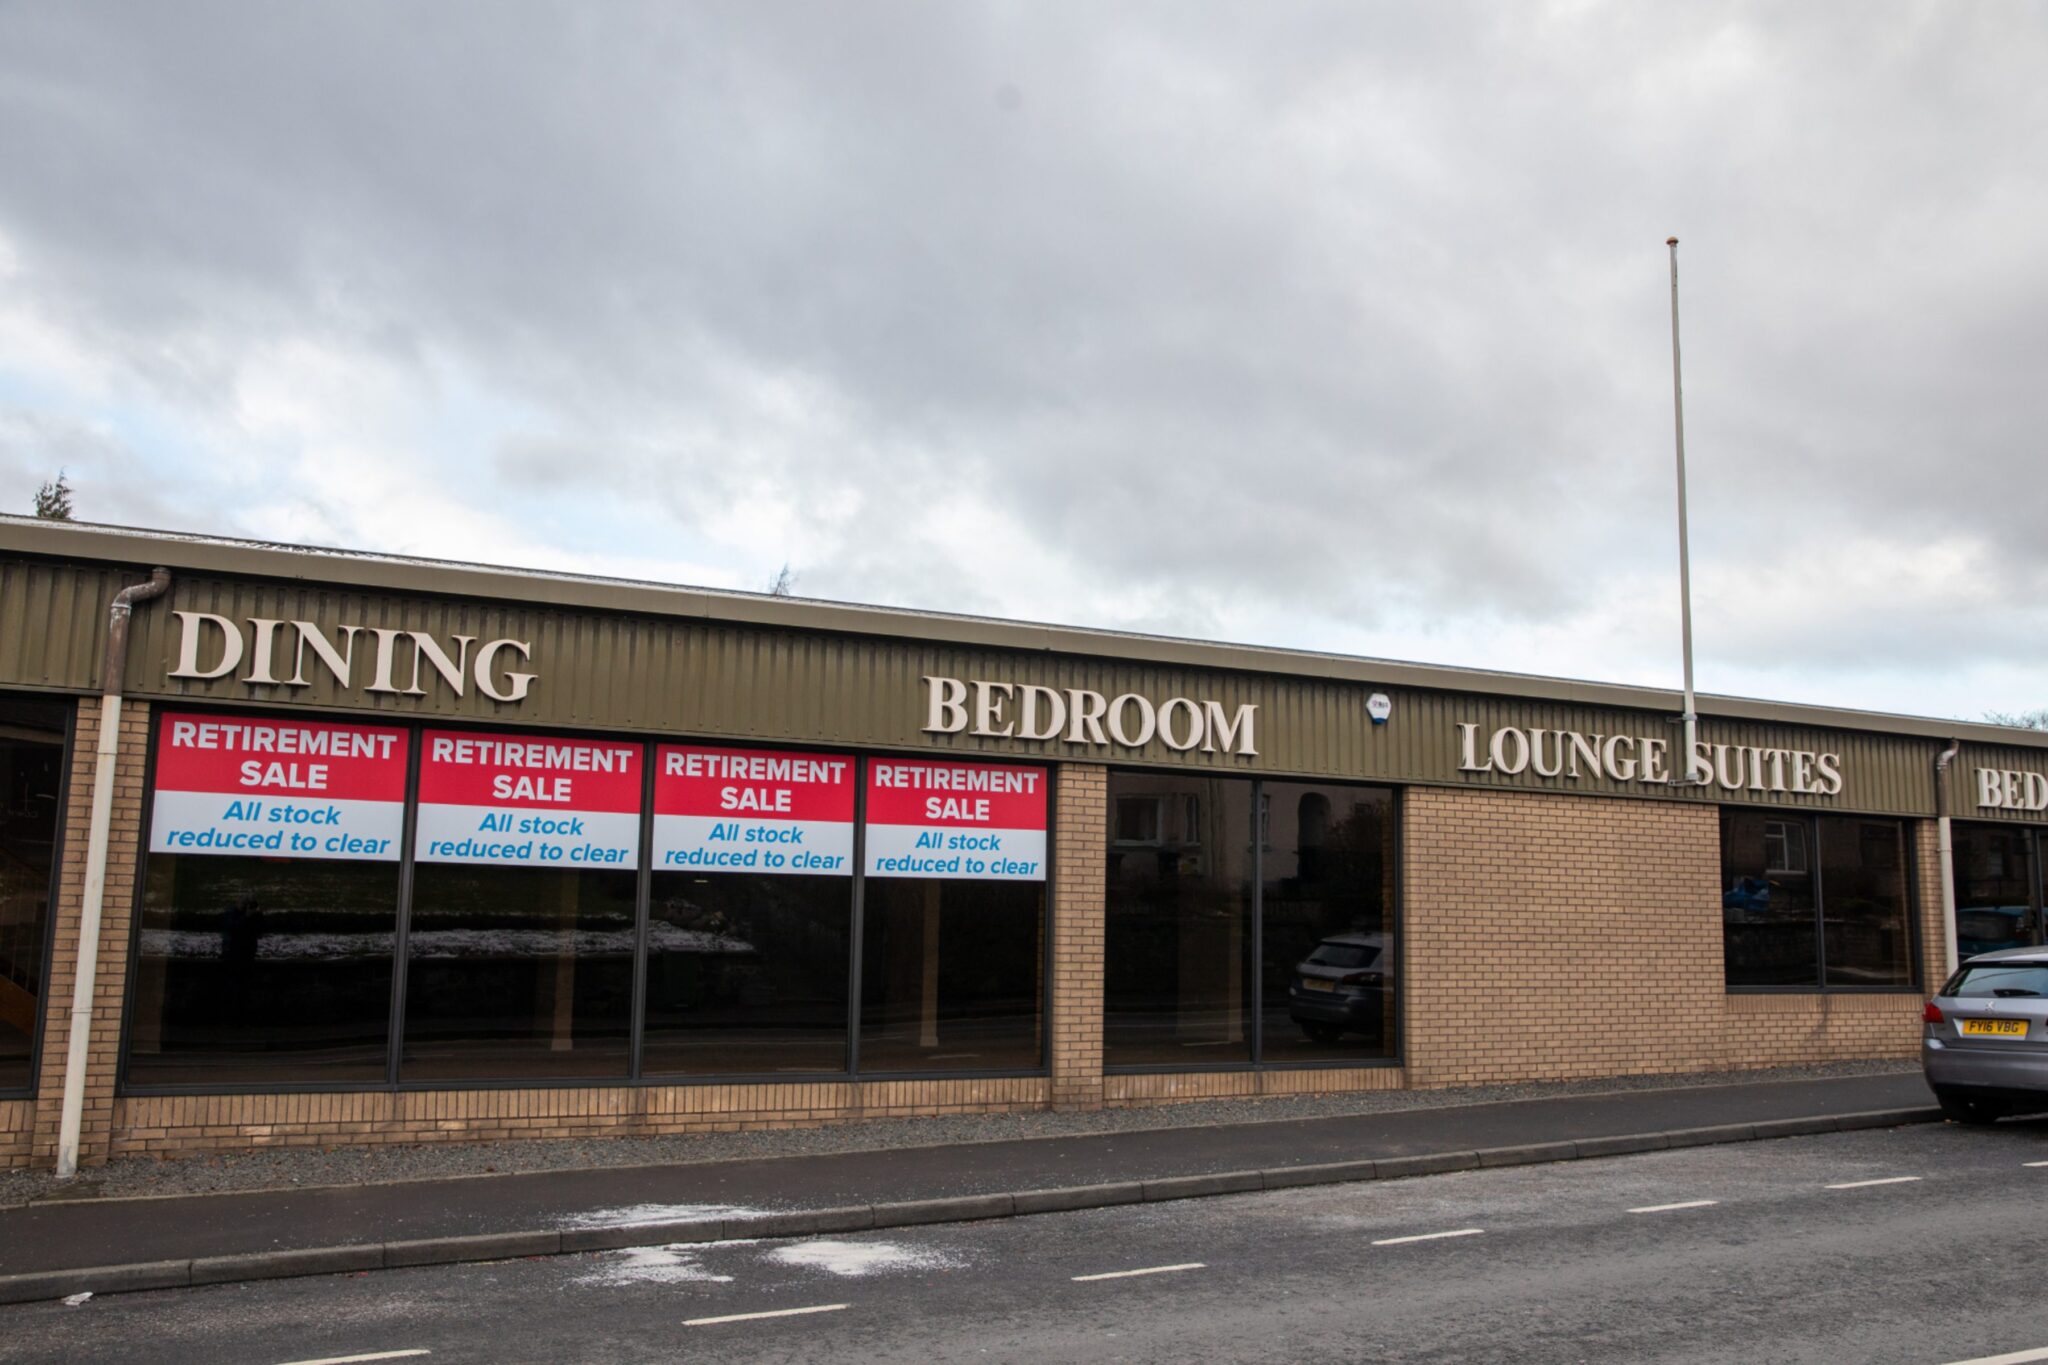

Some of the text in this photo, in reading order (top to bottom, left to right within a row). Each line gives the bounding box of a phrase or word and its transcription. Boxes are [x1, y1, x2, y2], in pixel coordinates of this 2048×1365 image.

[168, 610, 539, 702] DINING
[920, 675, 1259, 755] BEDROOM
[171, 721, 397, 759] RETIREMENT
[432, 737, 633, 773] RETIREMENT
[665, 752, 846, 784] RETIREMENT
[1456, 722, 1843, 795] LOUNGE SUITES
[239, 760, 328, 790] SALE
[492, 774, 572, 802] SALE
[875, 764, 1039, 794] RETIREMENT
[720, 786, 792, 812] SALE
[1976, 767, 2048, 811] BED
[222, 800, 342, 825] All stock
[925, 796, 990, 821] SALE
[478, 813, 585, 836] All stock
[708, 823, 804, 844] All stock
[166, 827, 391, 854] reduced to clear
[429, 838, 629, 863] reduced to clear
[915, 831, 1001, 851] All stock
[665, 847, 845, 870] reduced to clear
[876, 854, 1038, 875] reduced to clear
[1969, 1020, 2019, 1033] FY16 VBG
